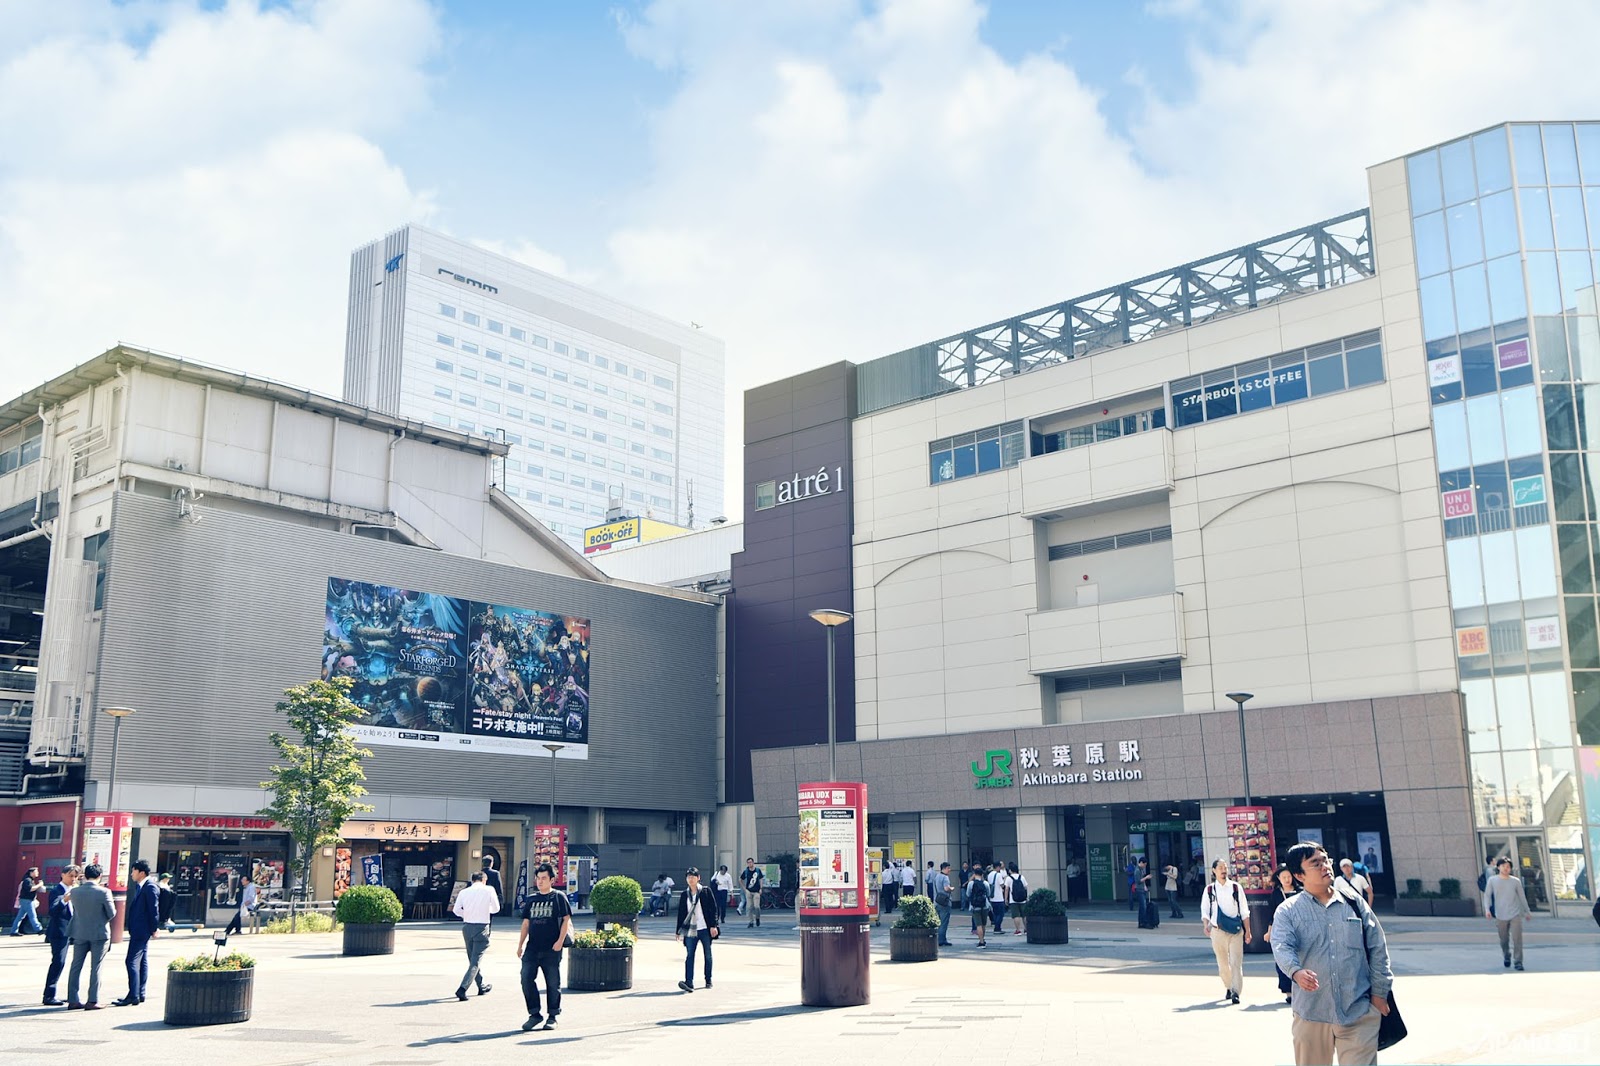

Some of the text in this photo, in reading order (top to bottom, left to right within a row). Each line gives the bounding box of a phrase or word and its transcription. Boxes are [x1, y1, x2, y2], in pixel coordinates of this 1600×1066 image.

[438, 268, 498, 294] remm
[1182, 370, 1302, 407] STARBUCKS COFFEE
[778, 466, 830, 503] atré
[1446, 494, 1467, 505] UNI
[1448, 503, 1470, 515] QLO
[1461, 632, 1483, 644] ABC
[1461, 642, 1485, 652] MART
[398, 648, 457, 668] STARFORGED
[413, 663, 442, 673] LEGENDS
[481, 708, 513, 718] Fate/stay
[1020, 740, 1140, 769] 秋葉原駅
[971, 749, 1013, 777] JR
[973, 776, 1013, 789] JR東日本
[1022, 768, 1142, 786] Akihabara Station
[816, 791, 830, 799] UDX
[149, 815, 276, 829] BECK'S COFFEE SHOP
[383, 824, 432, 837] 回転寿司
